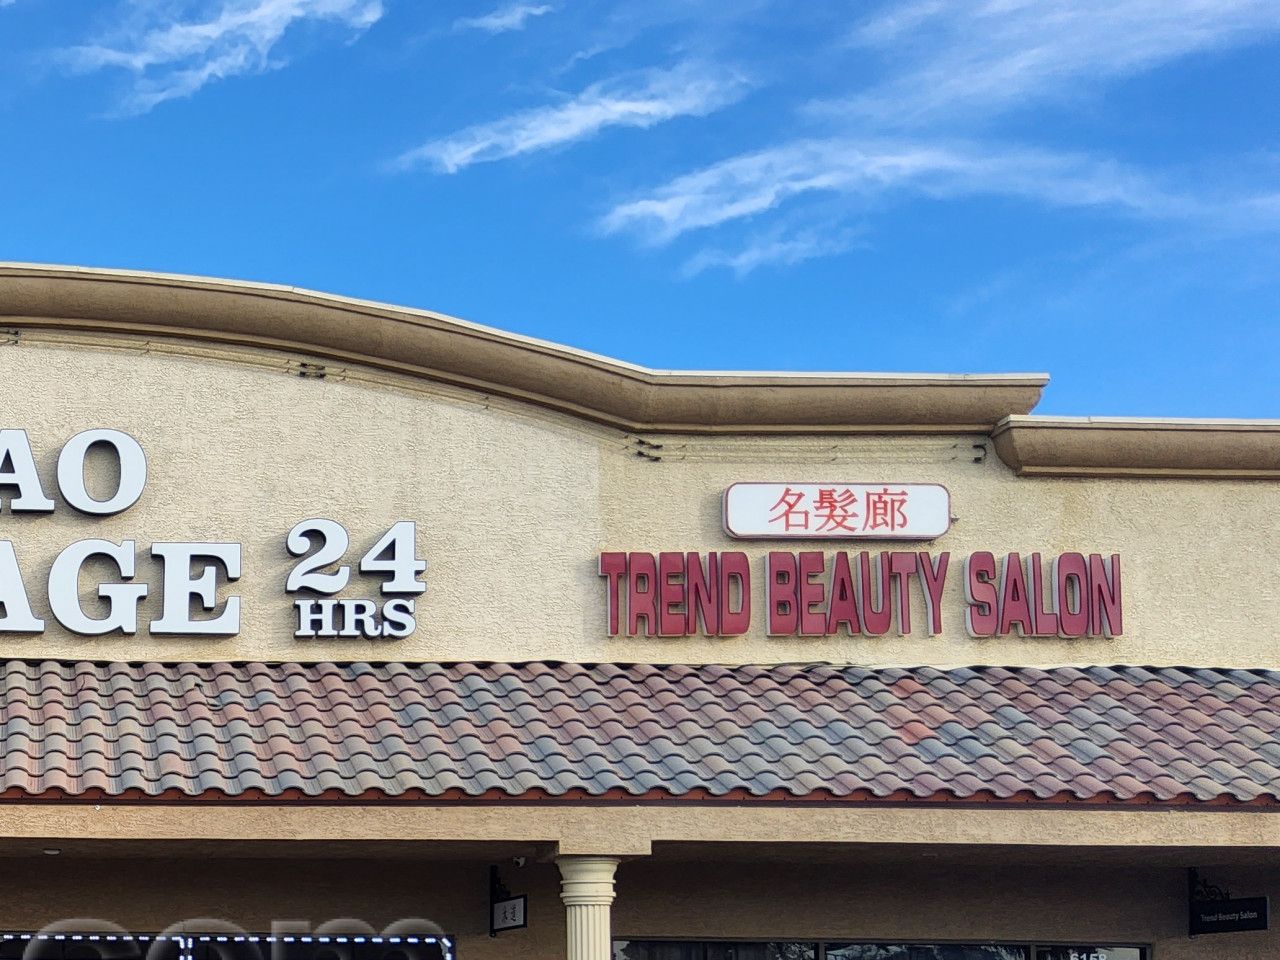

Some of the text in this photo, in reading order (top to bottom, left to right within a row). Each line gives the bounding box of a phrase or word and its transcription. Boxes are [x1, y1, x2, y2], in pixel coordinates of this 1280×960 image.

[768, 487, 910, 532] 名髮廊
[286, 518, 428, 594] 24
[598, 551, 1124, 639] TREND BEAUTY SALON
[293, 598, 418, 639] HRS
[1240, 911, 1258, 919] Salon
